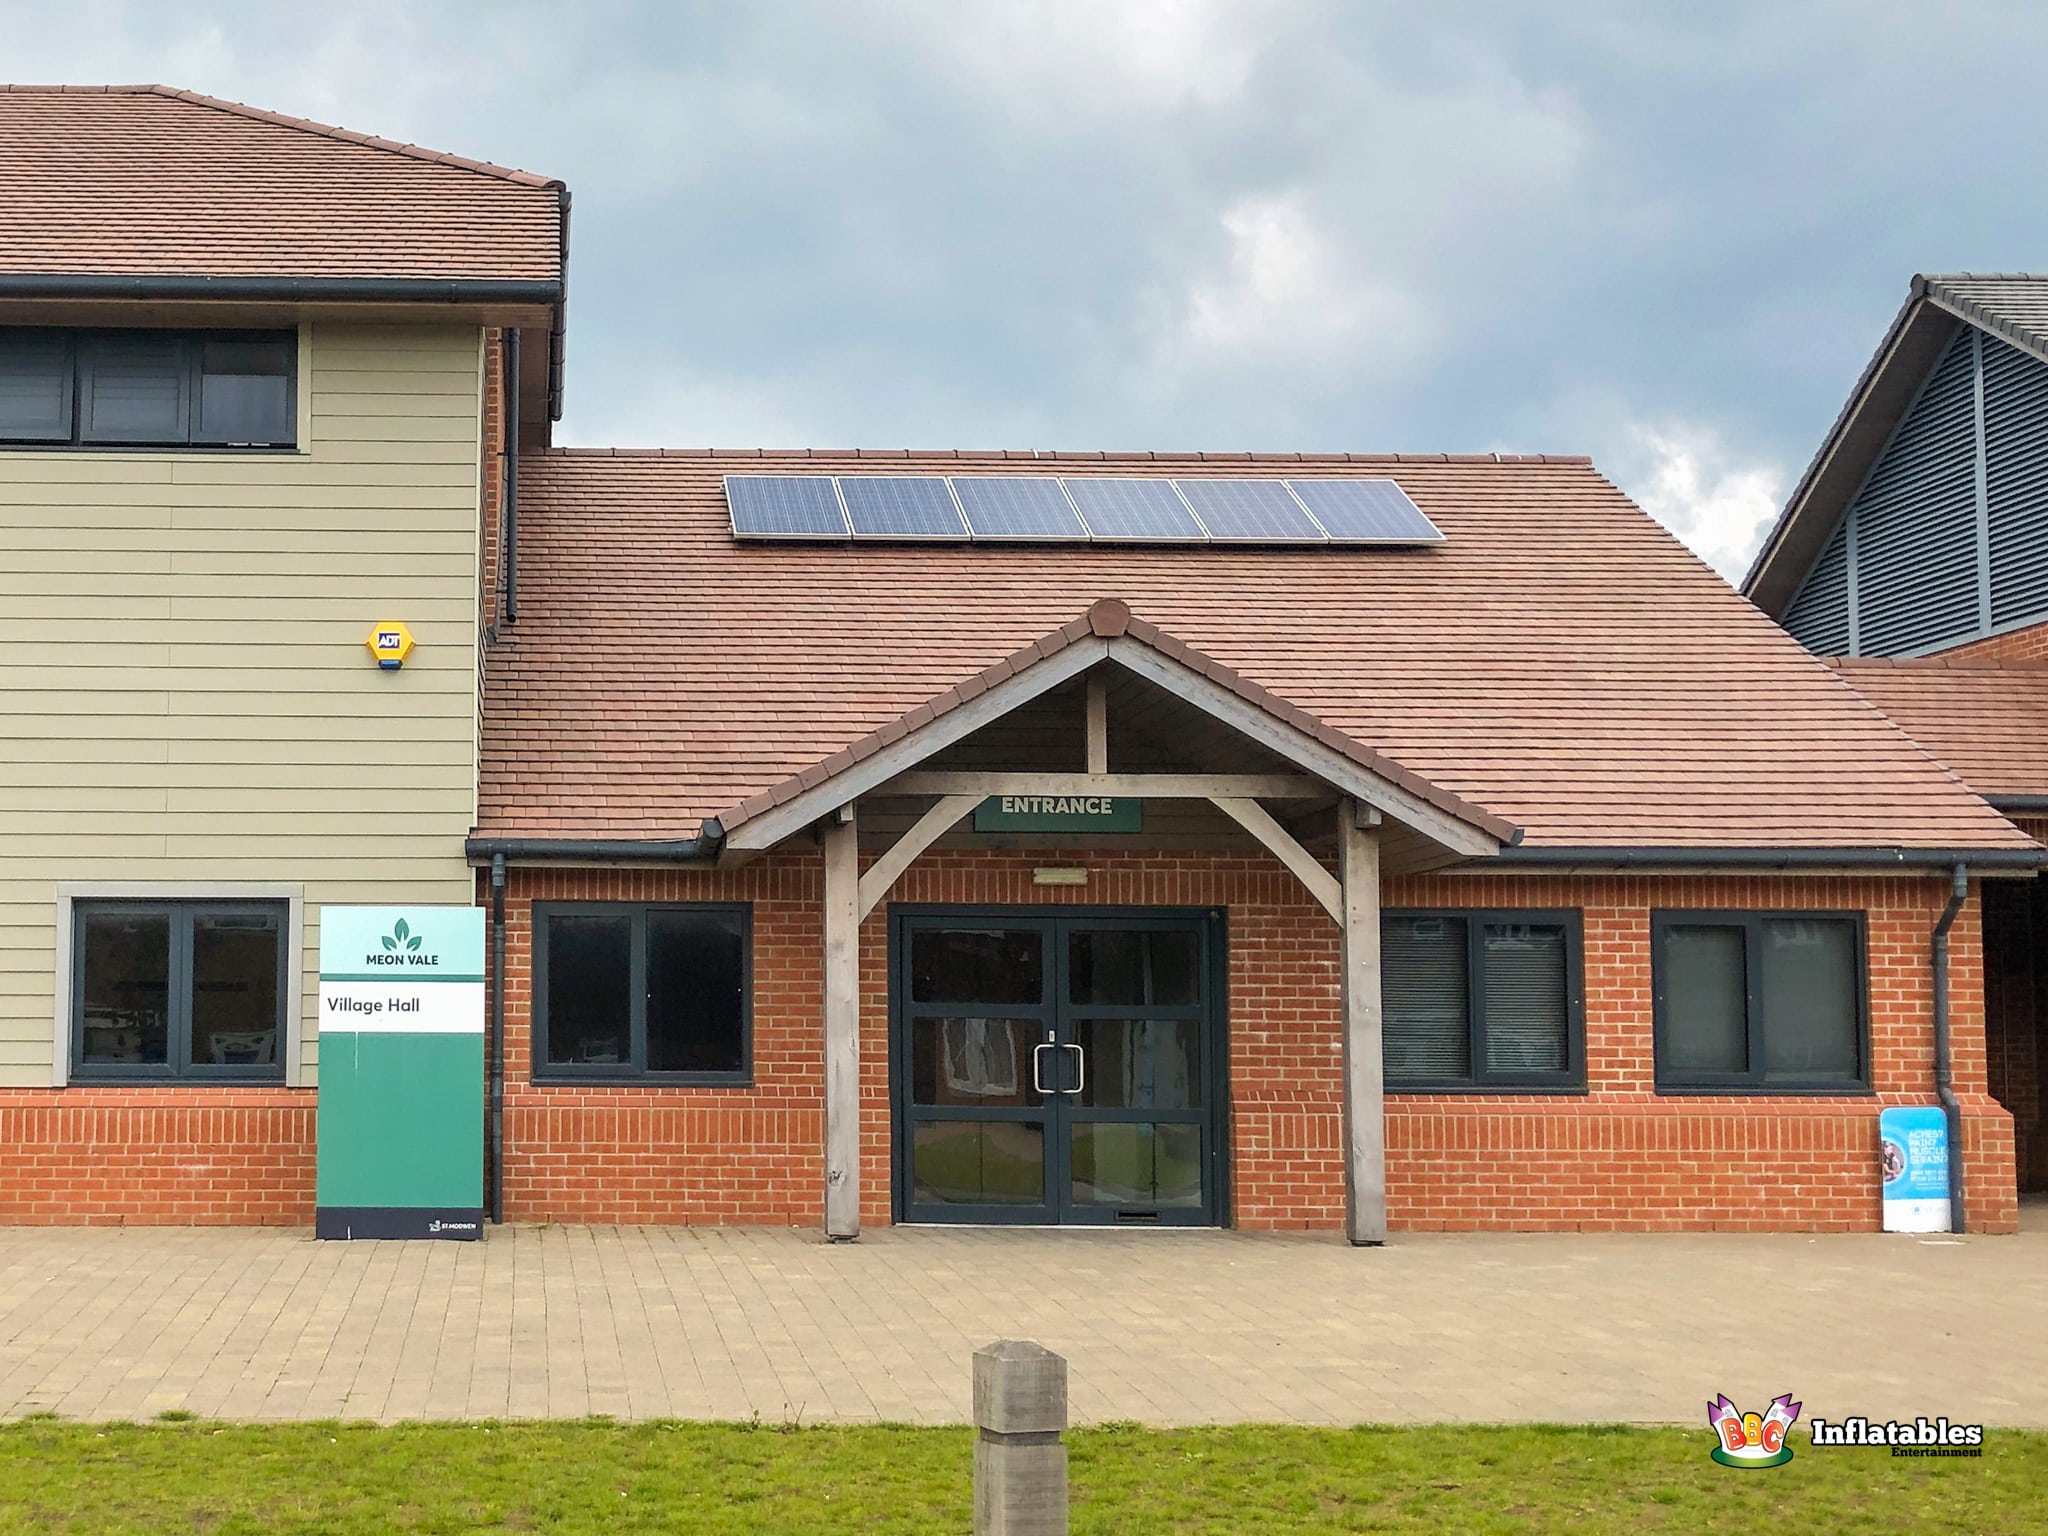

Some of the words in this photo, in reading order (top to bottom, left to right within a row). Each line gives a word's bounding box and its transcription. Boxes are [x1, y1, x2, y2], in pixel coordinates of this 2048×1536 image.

[379, 635, 400, 647] ADT
[1001, 797, 1113, 814] ENTRANCE
[366, 954, 404, 966] MEON
[407, 954, 439, 966] VALE
[327, 997, 383, 1015] Village
[388, 997, 420, 1012] Hall
